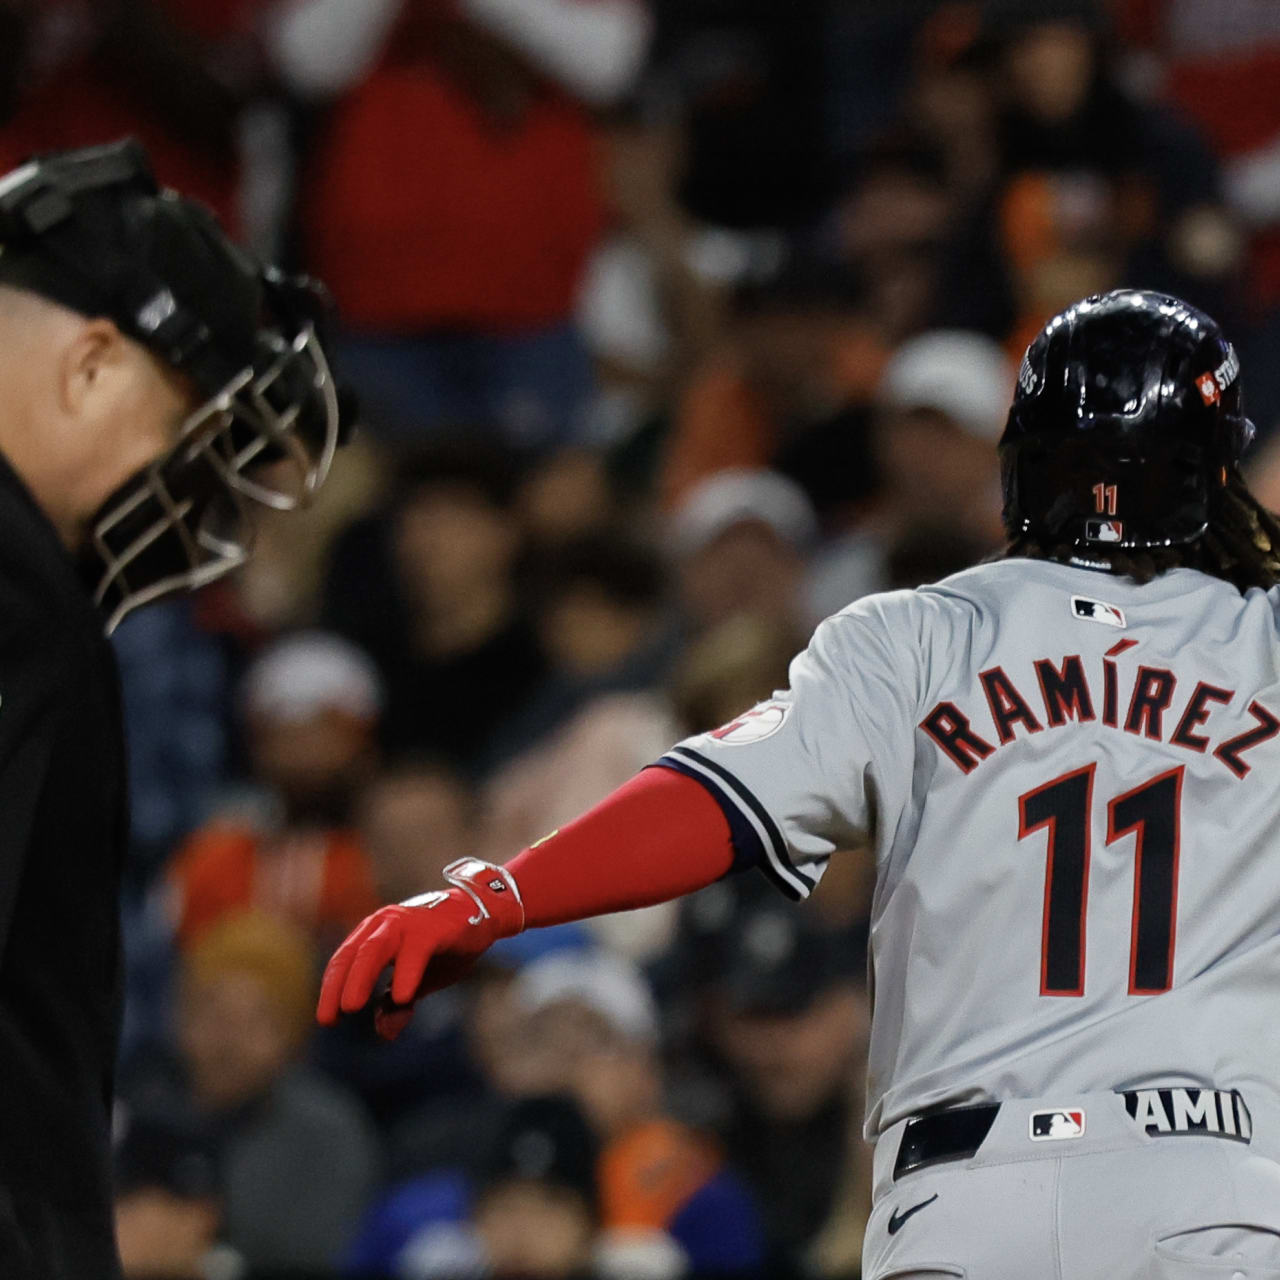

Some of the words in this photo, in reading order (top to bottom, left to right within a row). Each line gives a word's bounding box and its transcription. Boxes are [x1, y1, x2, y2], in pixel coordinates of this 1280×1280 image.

[1092, 482, 1117, 516] 11
[1017, 761, 1186, 998] 11
[1136, 1088, 1252, 1140] AMI
